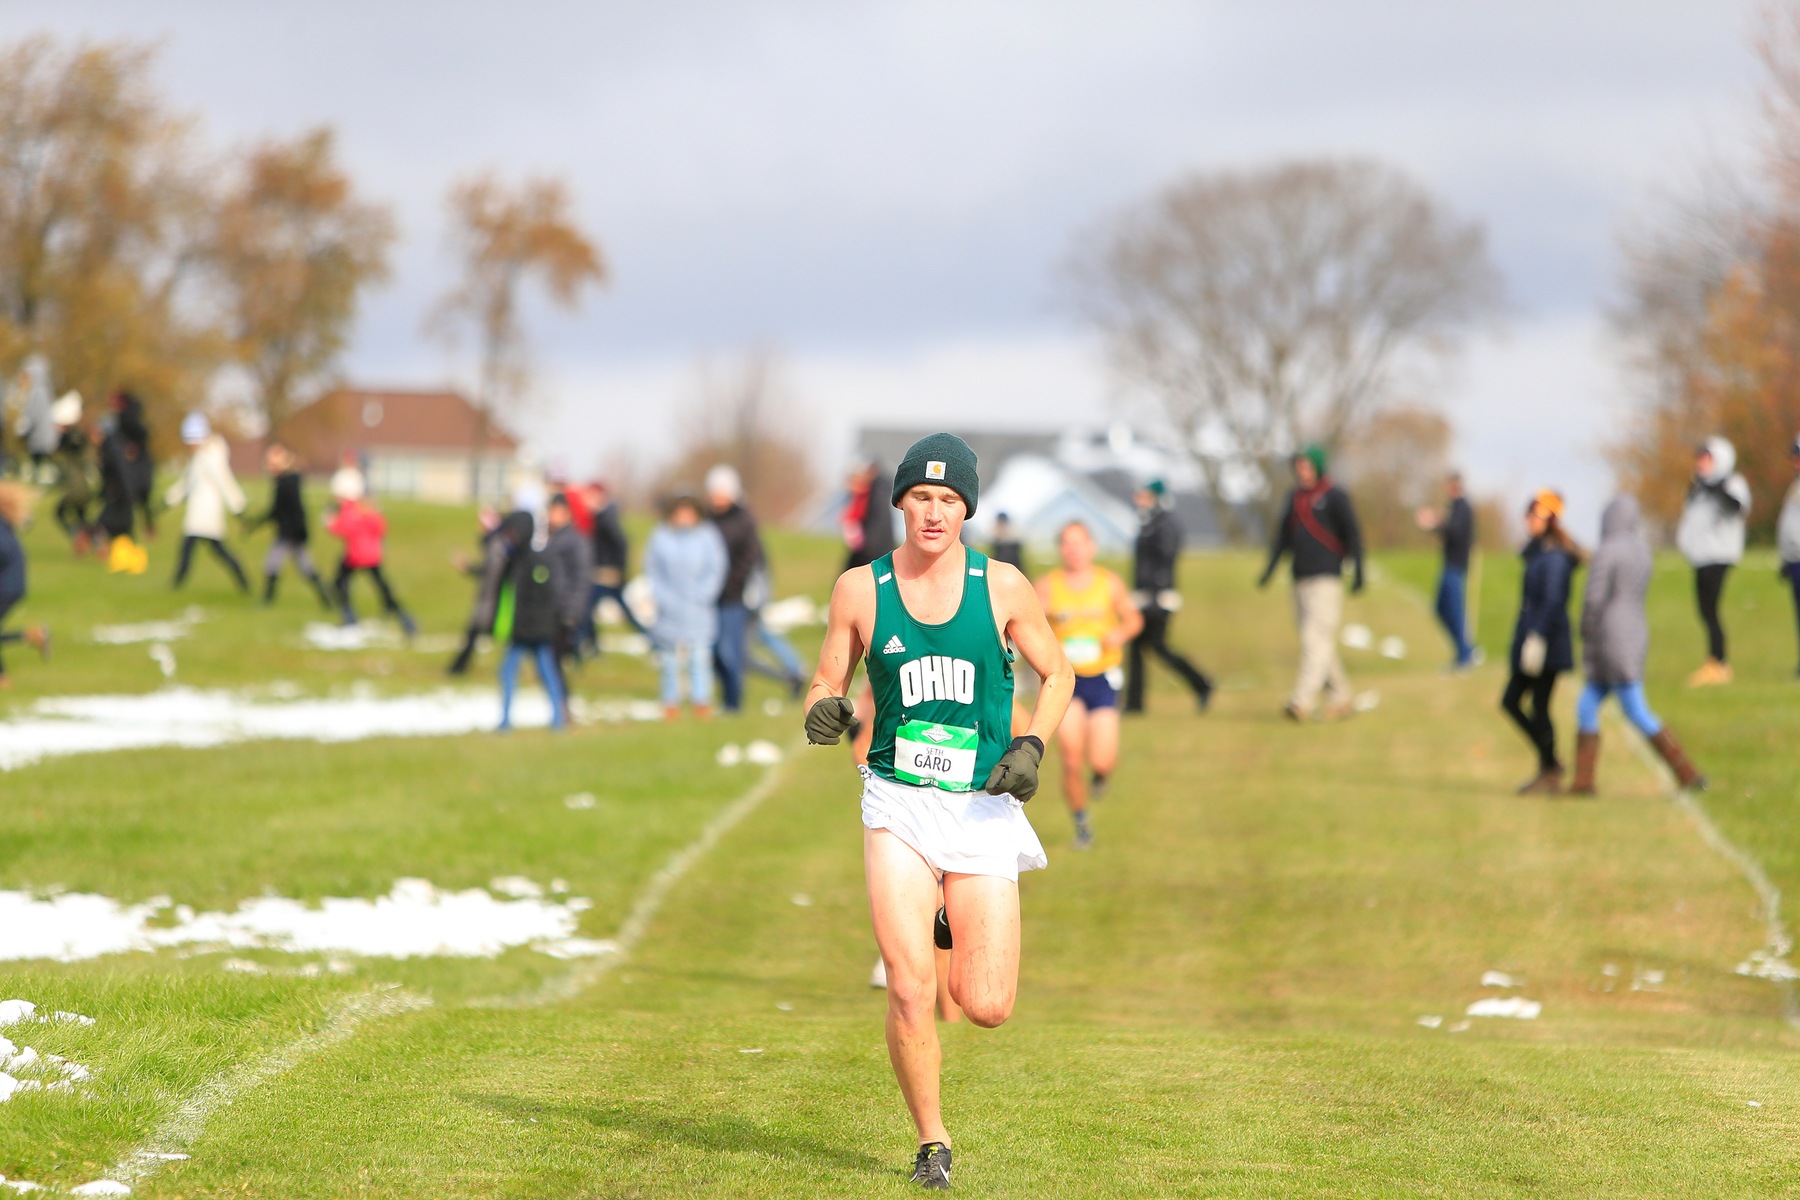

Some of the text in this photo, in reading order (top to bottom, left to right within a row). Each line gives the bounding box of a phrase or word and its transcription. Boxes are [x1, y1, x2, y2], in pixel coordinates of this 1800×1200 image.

[883, 646, 906, 655] adidas
[900, 655, 975, 708] OHIO
[926, 747, 944, 756] SETH
[914, 754, 952, 772] GARD
